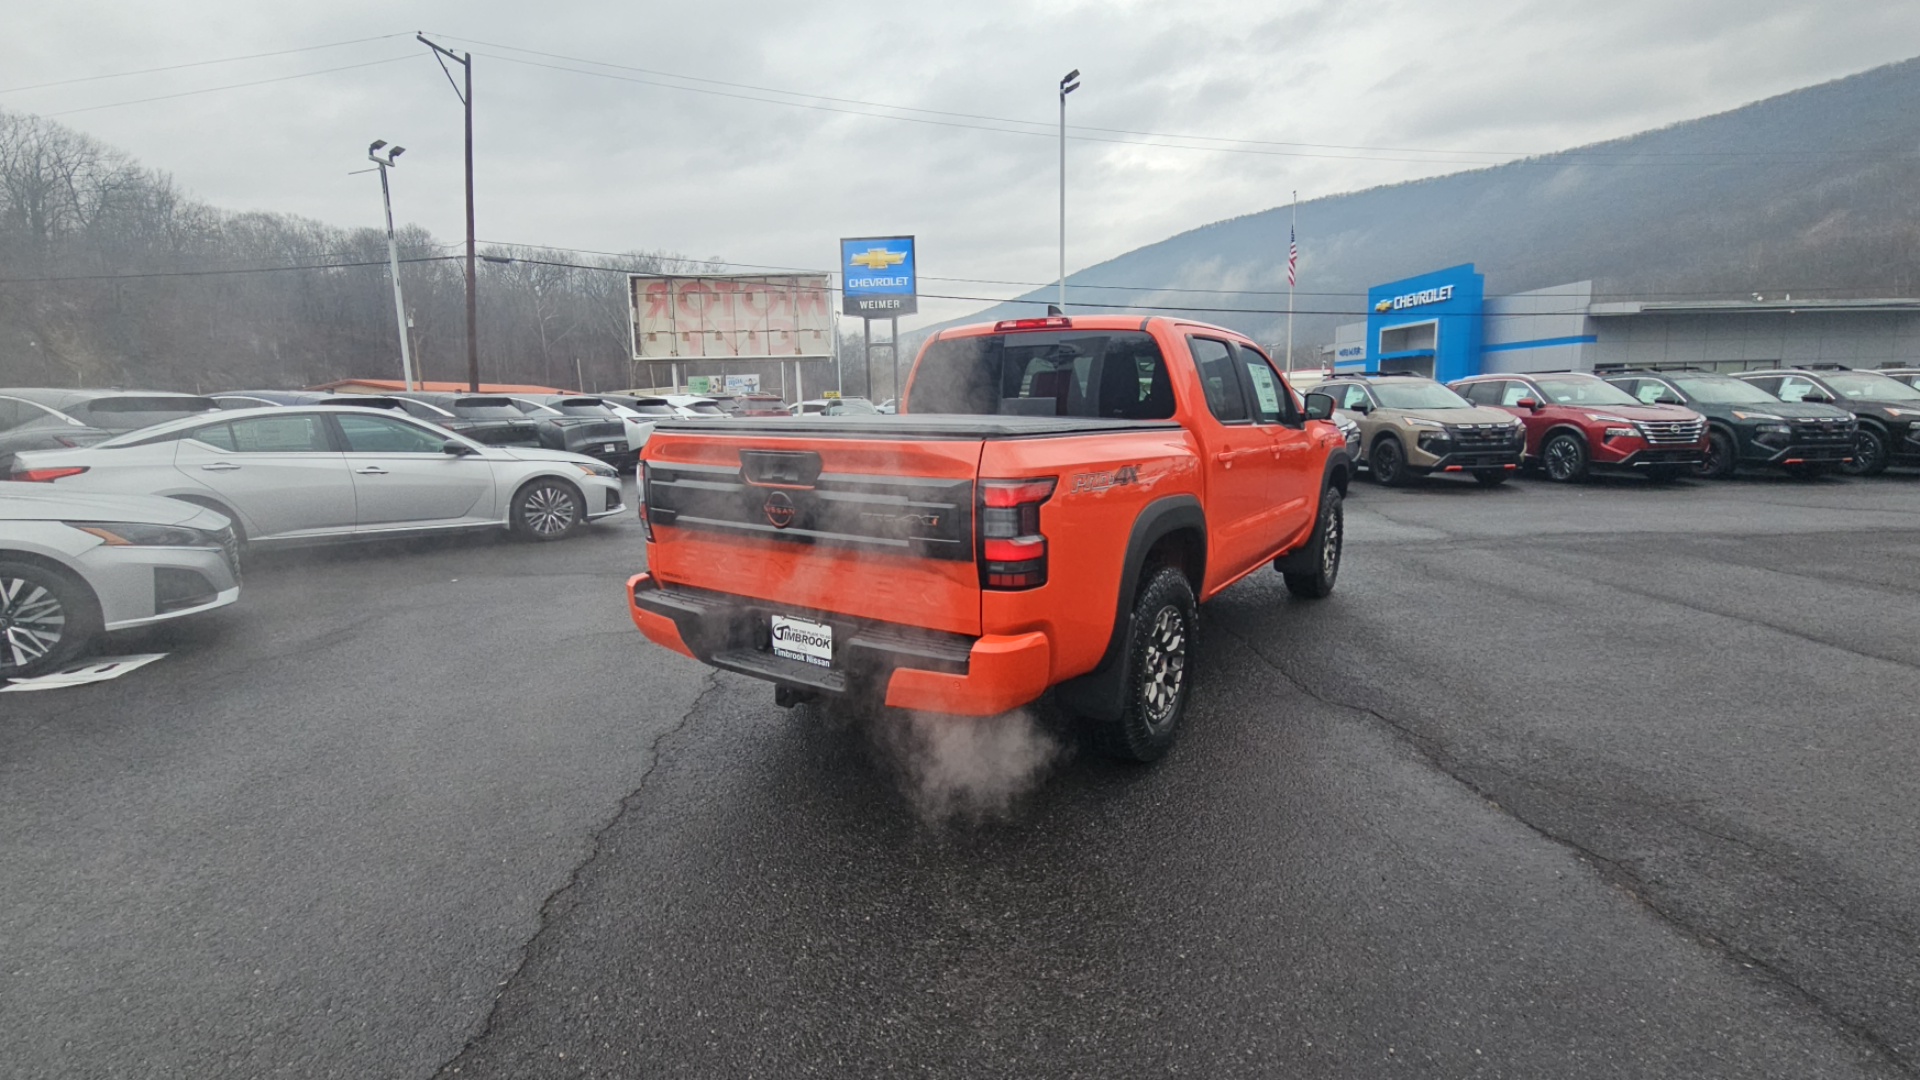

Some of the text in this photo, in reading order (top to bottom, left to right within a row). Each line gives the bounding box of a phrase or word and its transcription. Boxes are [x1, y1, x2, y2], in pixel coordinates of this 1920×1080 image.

[848, 276, 909, 288] CHEVROLET
[1393, 284, 1454, 310] CHEVROLET
[860, 299, 900, 309] WEIMER
[763, 504, 795, 516] NISSAN
[774, 647, 830, 667] Timbrook Nissan
